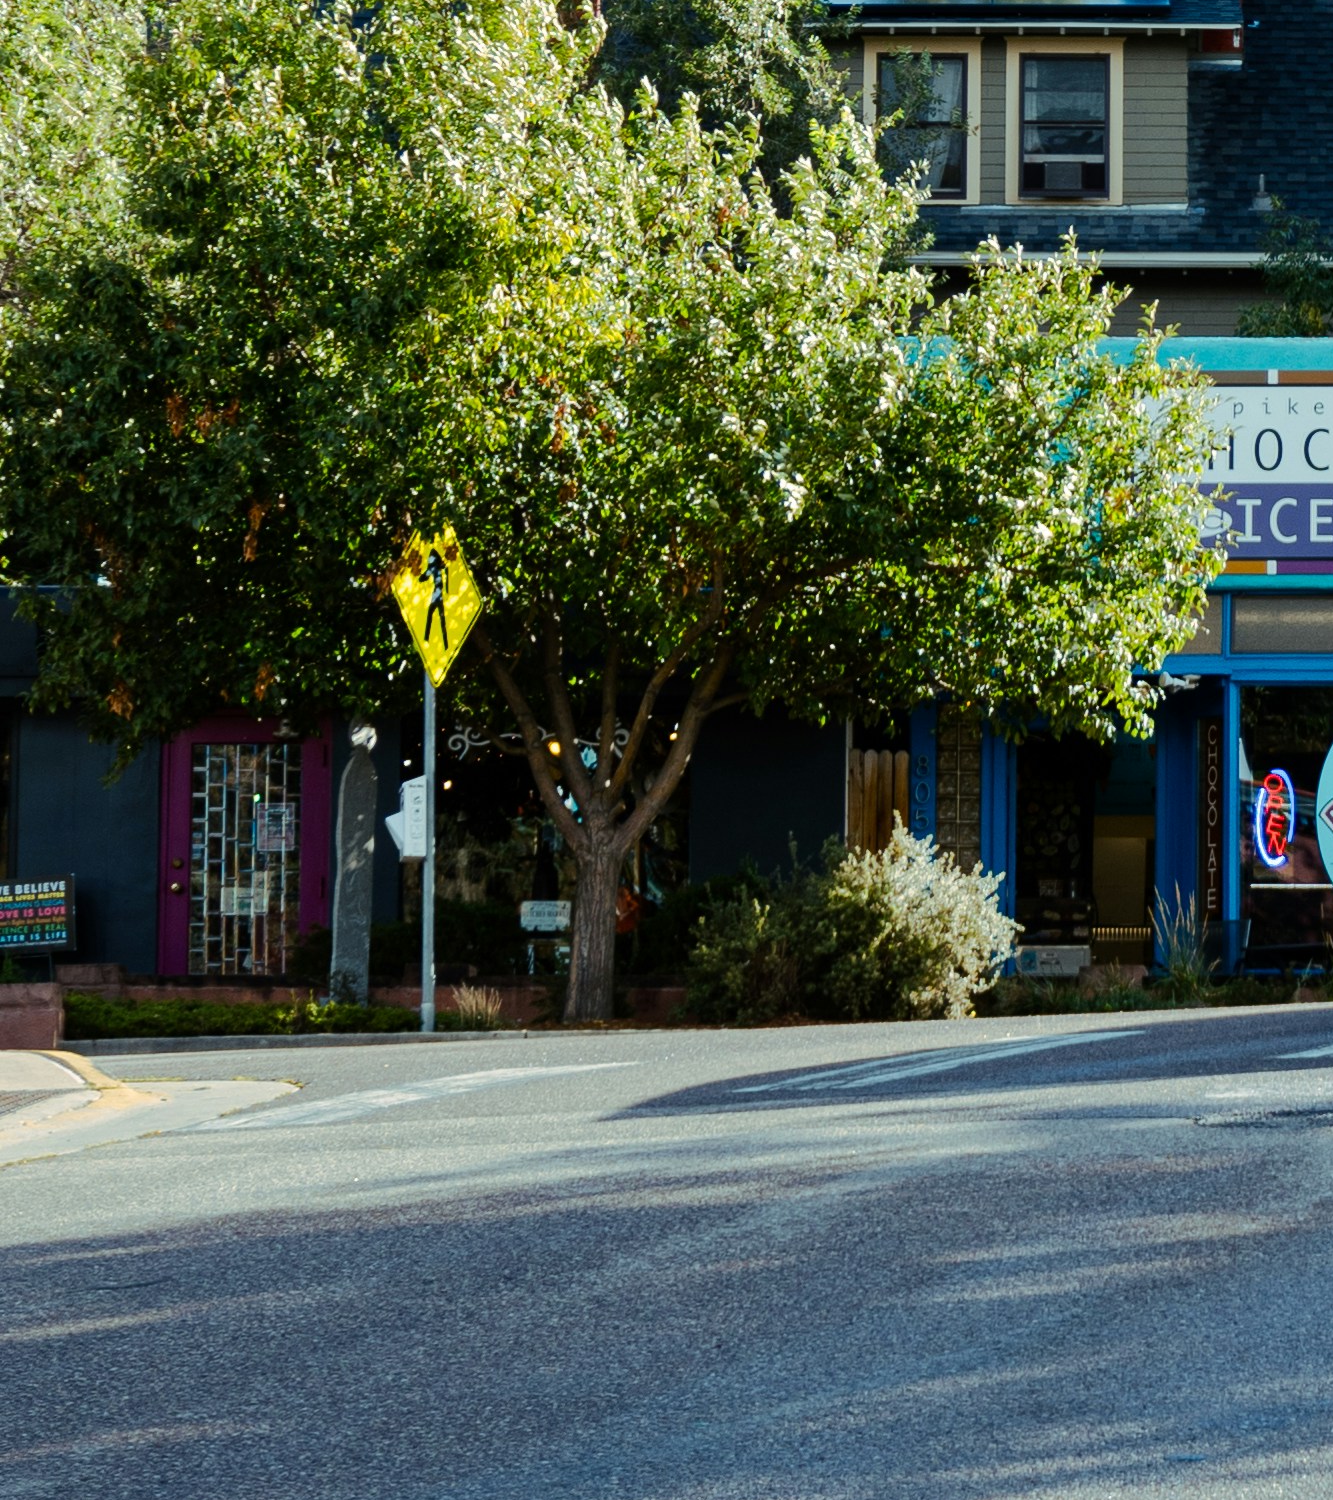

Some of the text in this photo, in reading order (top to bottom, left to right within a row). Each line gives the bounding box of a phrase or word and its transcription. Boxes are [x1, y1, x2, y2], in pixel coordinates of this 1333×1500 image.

[914, 754, 931, 831] 805
[1263, 773, 1288, 857] OPEN
[1207, 724, 1218, 910] CHOCOLATE
[15, 881, 66, 895] BELIEVE
[0, 906, 66, 919] OVE IS LOVE
[0, 934, 25, 942] ATER
[45, 931, 67, 940] LIFE
